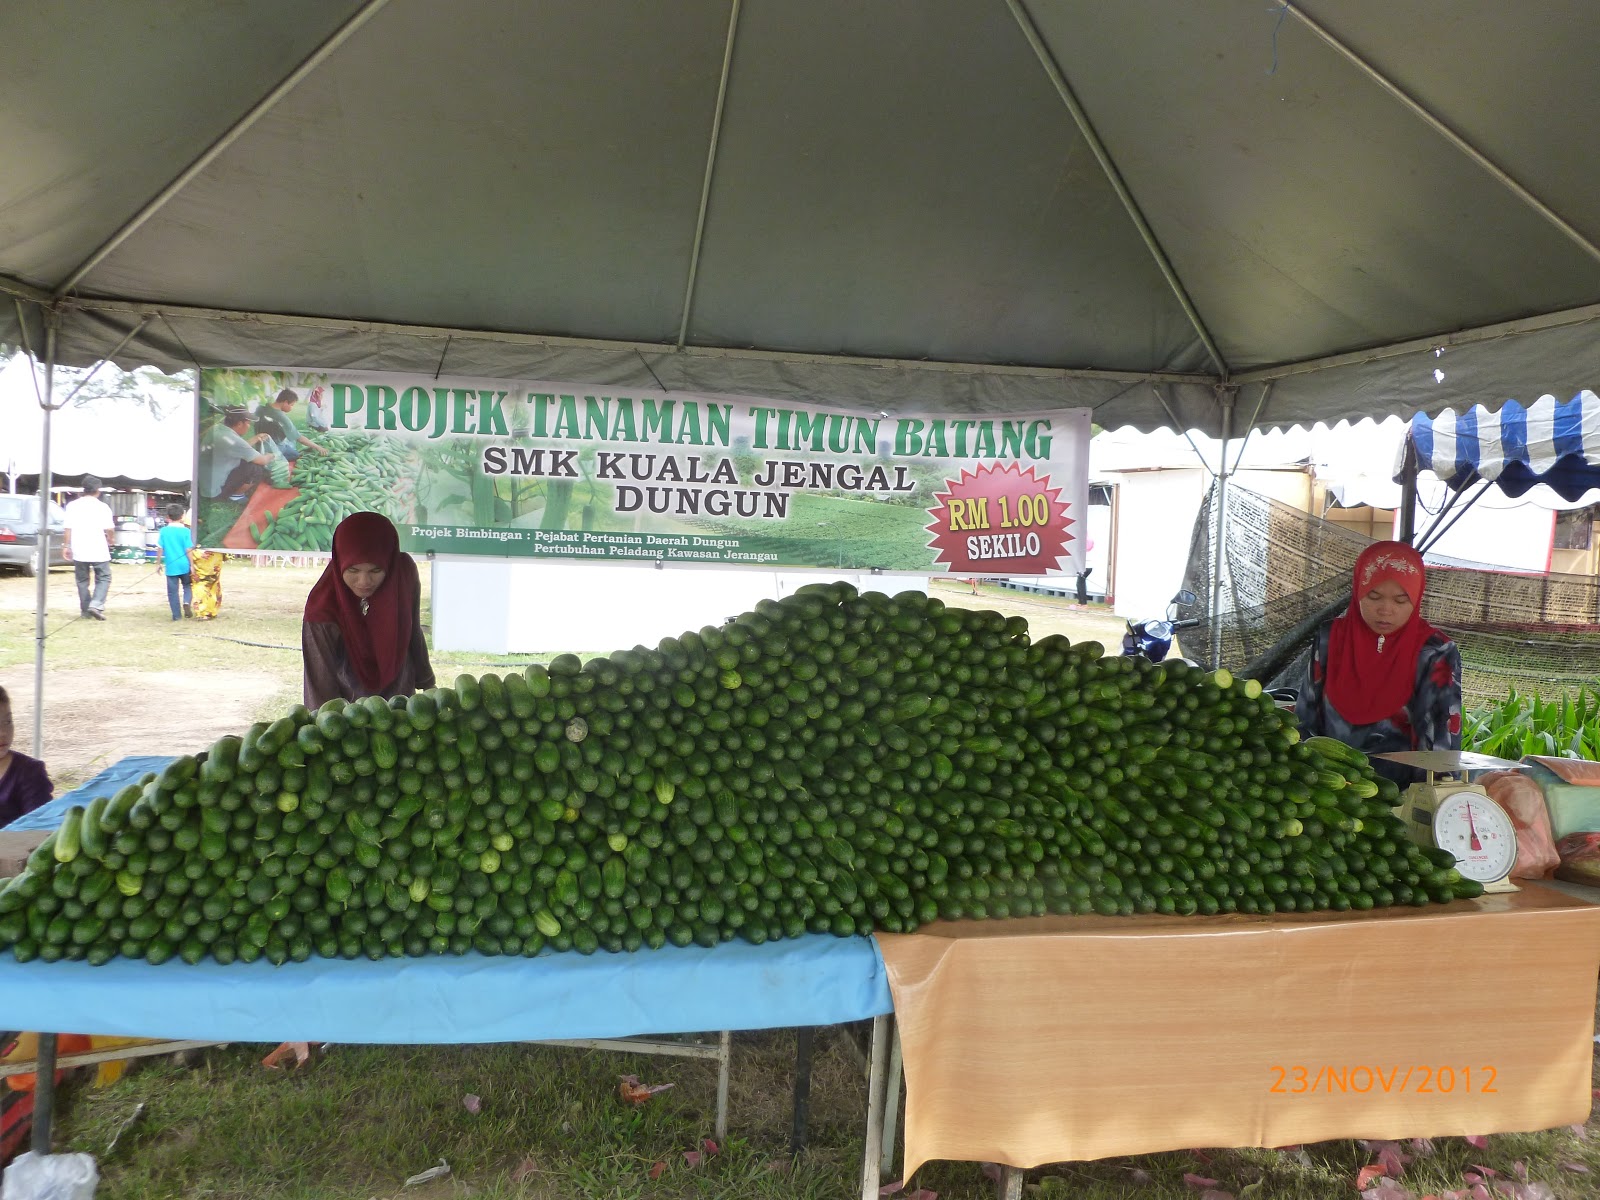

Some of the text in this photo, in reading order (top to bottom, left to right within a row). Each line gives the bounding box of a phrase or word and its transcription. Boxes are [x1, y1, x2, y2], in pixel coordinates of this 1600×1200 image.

[331, 384, 1053, 461] PROJEK TANAMAN TIMUN BATANG
[484, 447, 916, 492] SMK KUALA JENGAL
[615, 485, 790, 519] DUNGUN
[948, 493, 1049, 532] RM 1.00
[411, 526, 452, 538] Projek
[456, 528, 522, 541] Bimbingan
[534, 531, 579, 543] Pejabat
[583, 533, 643, 545] Pertanian
[646, 535, 689, 546] Daerah
[692, 538, 740, 549] Dungun
[534, 543, 778, 562] Pertubuhan Peladang Kawasan Jerangau
[967, 531, 1041, 560] SEKILO
